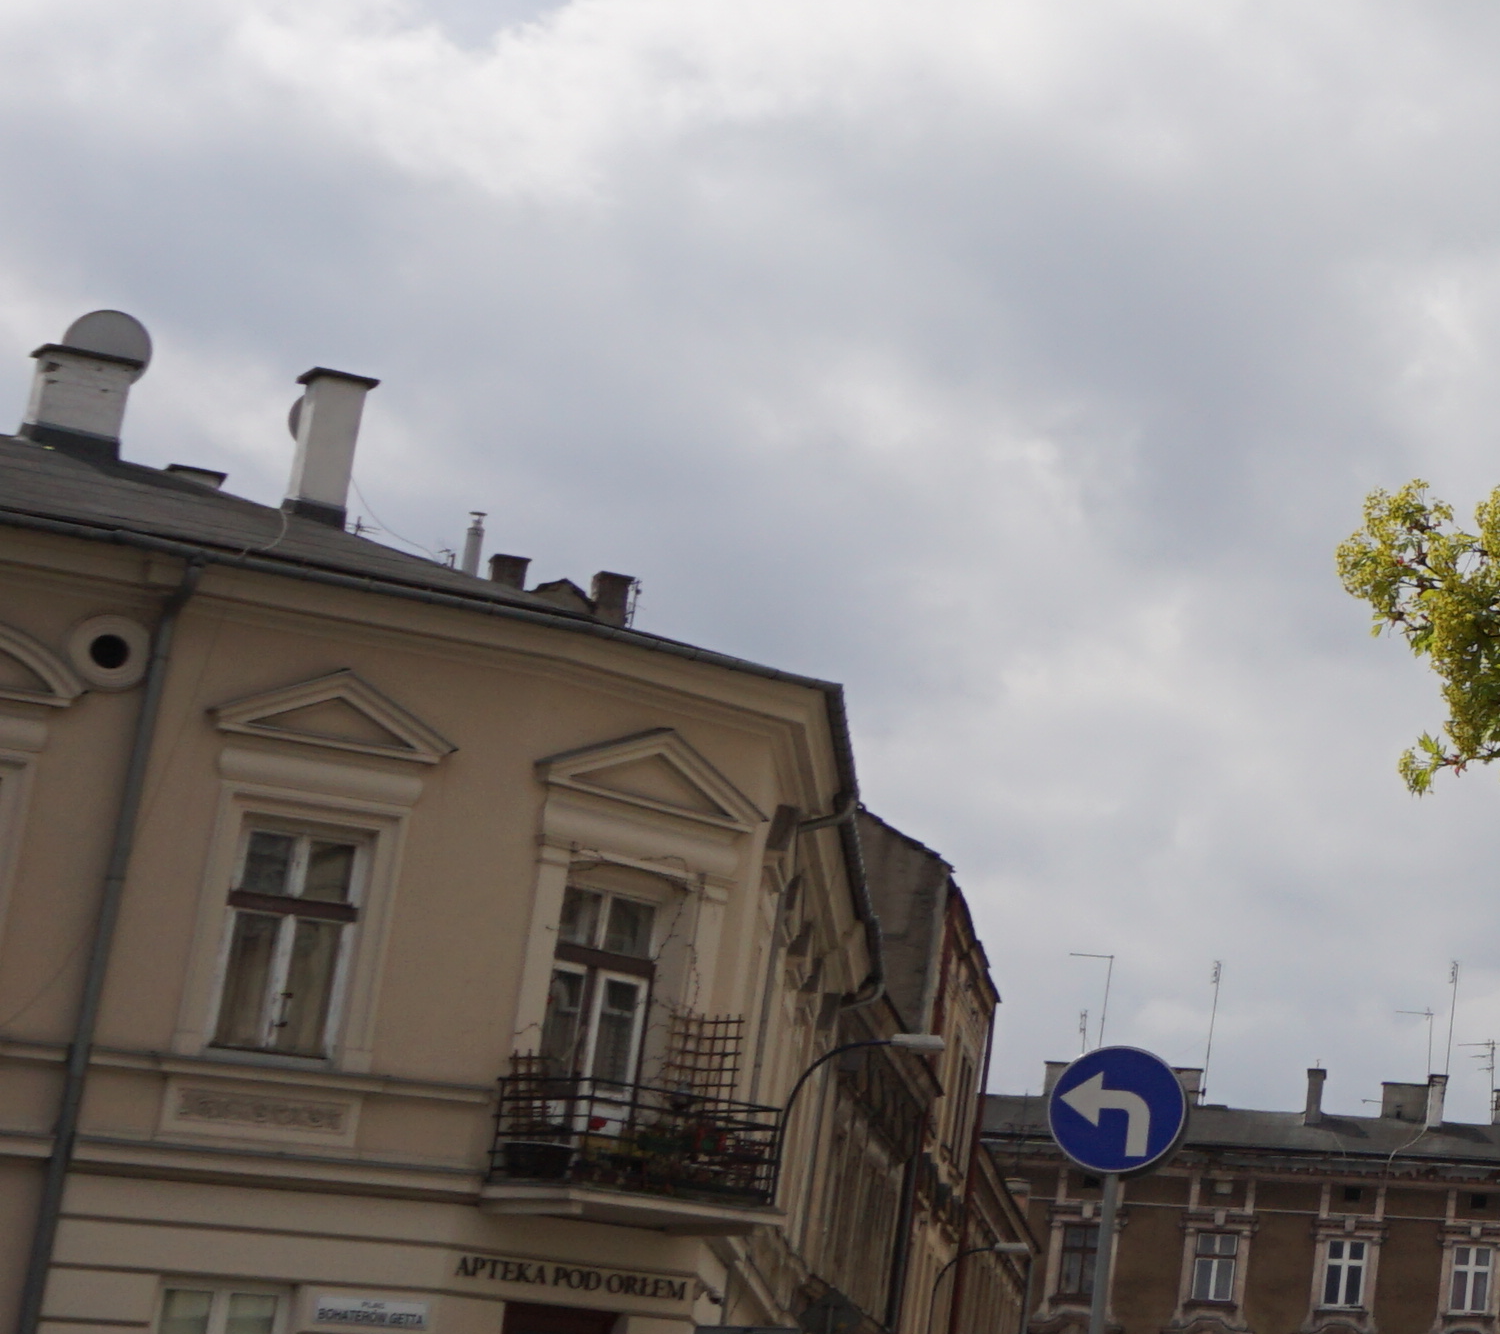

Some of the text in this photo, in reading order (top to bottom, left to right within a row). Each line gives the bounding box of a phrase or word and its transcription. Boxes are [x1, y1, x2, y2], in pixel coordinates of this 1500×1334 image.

[456, 1255, 687, 1300] APTEKA POD ORŁEM
